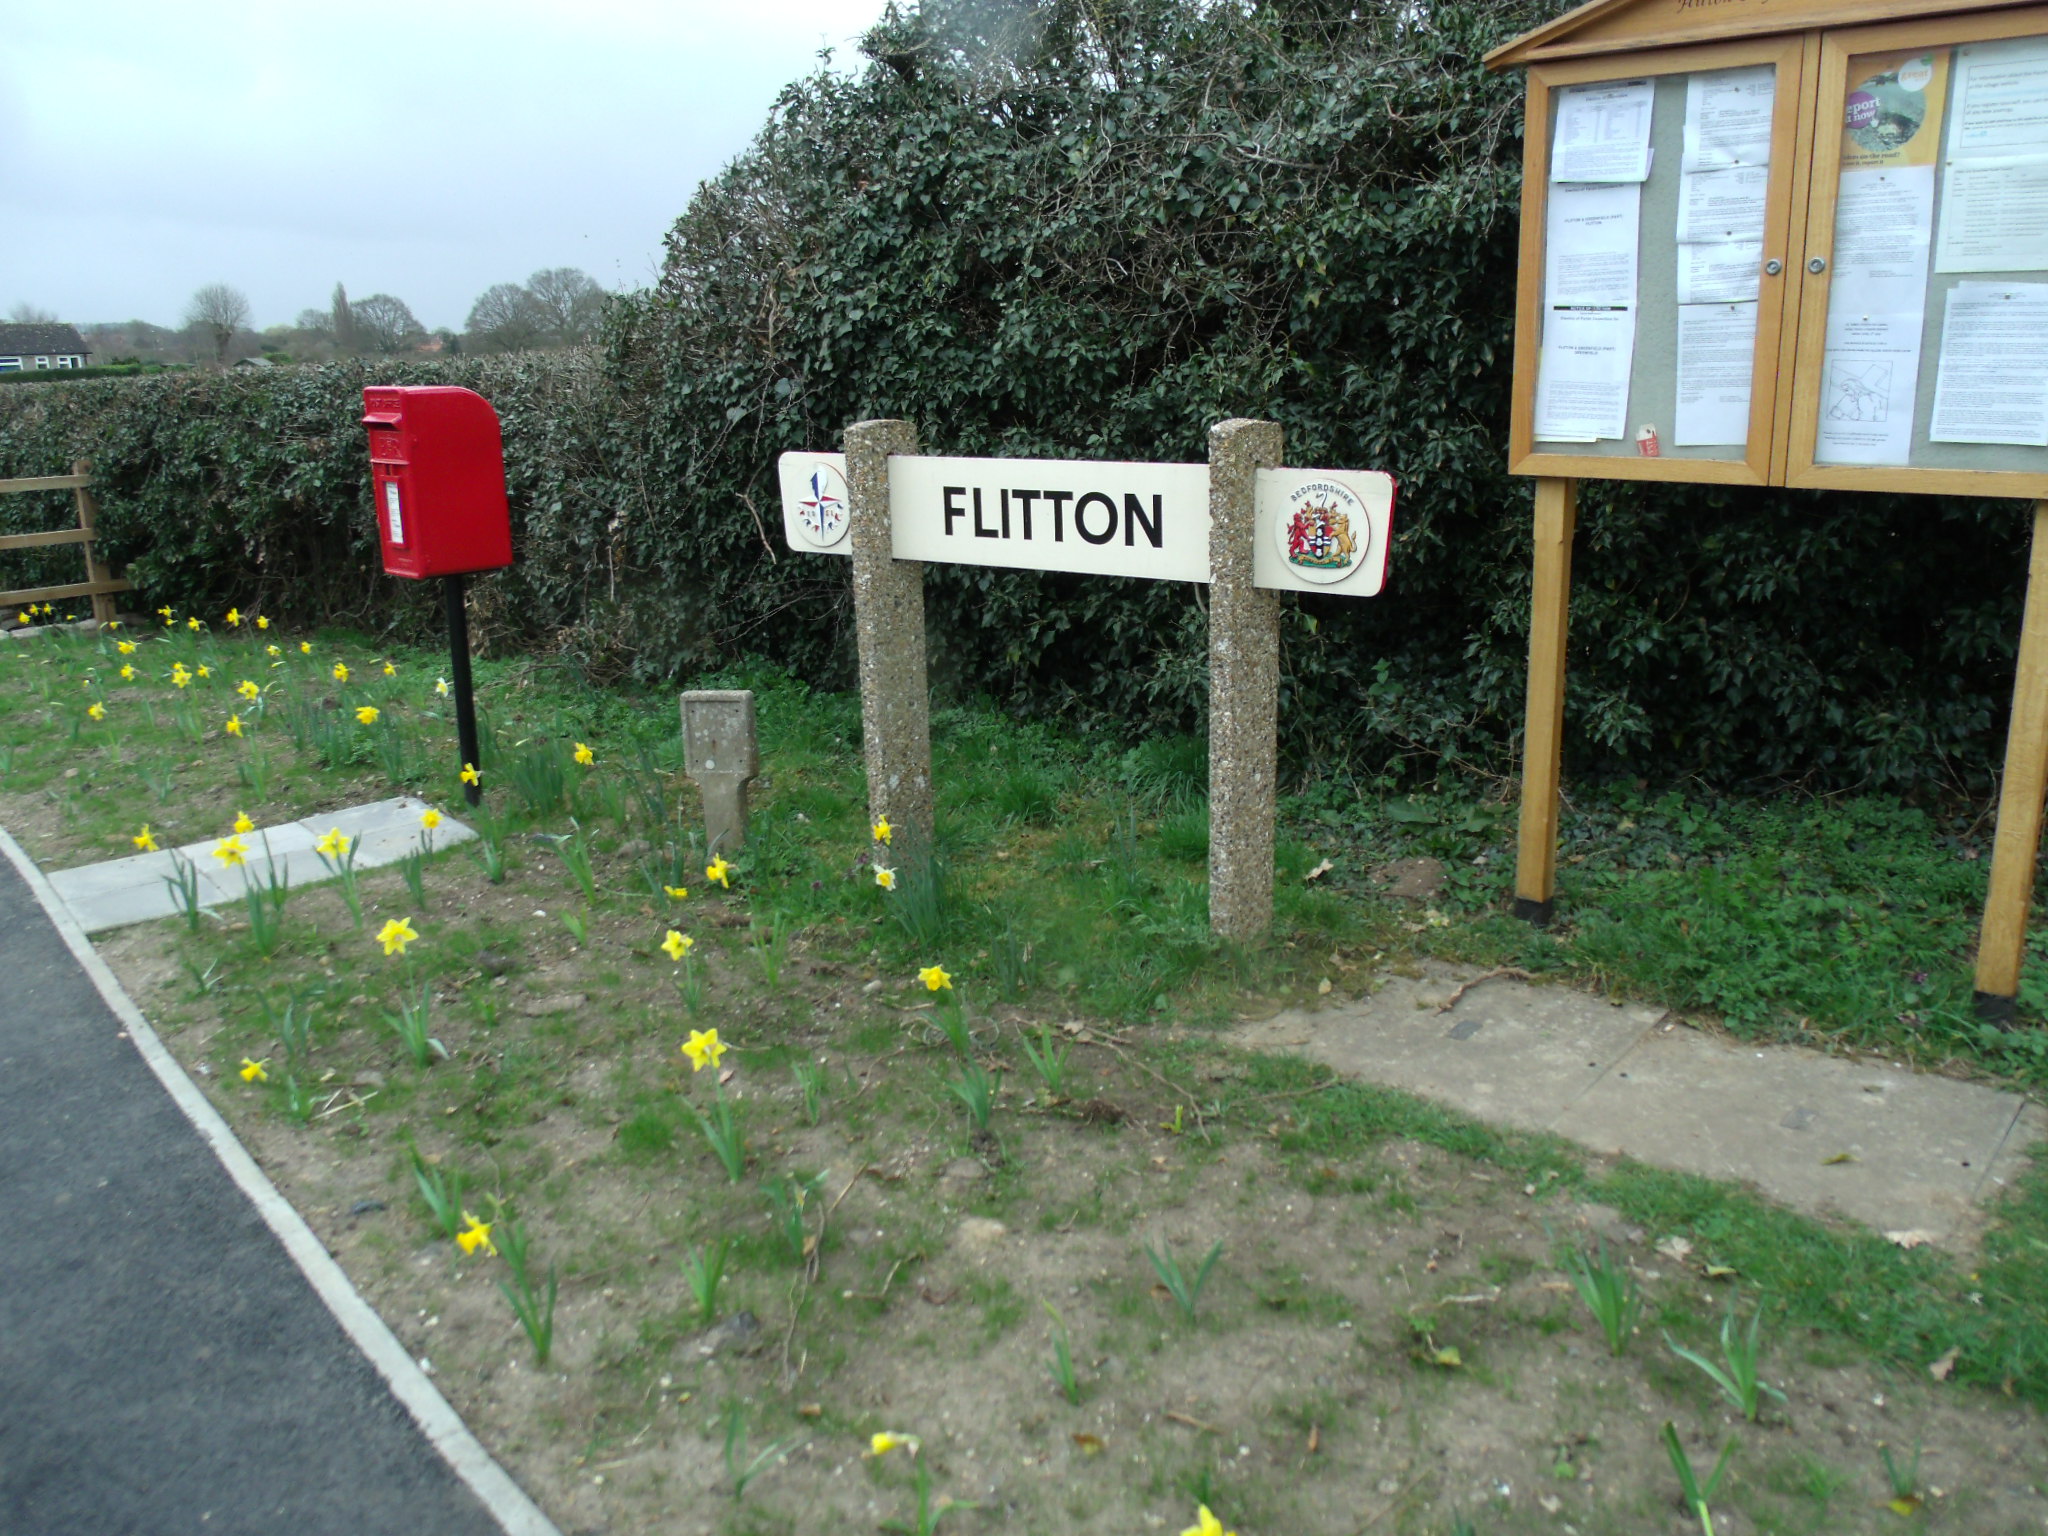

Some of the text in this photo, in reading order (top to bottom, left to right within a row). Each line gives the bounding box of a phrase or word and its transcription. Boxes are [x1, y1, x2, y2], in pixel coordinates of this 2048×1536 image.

[1846, 97, 1880, 115] eport
[1853, 110, 1876, 121] now
[1290, 483, 1355, 506] BEDFORDSHIRE
[943, 486, 1163, 549] FLITTON
